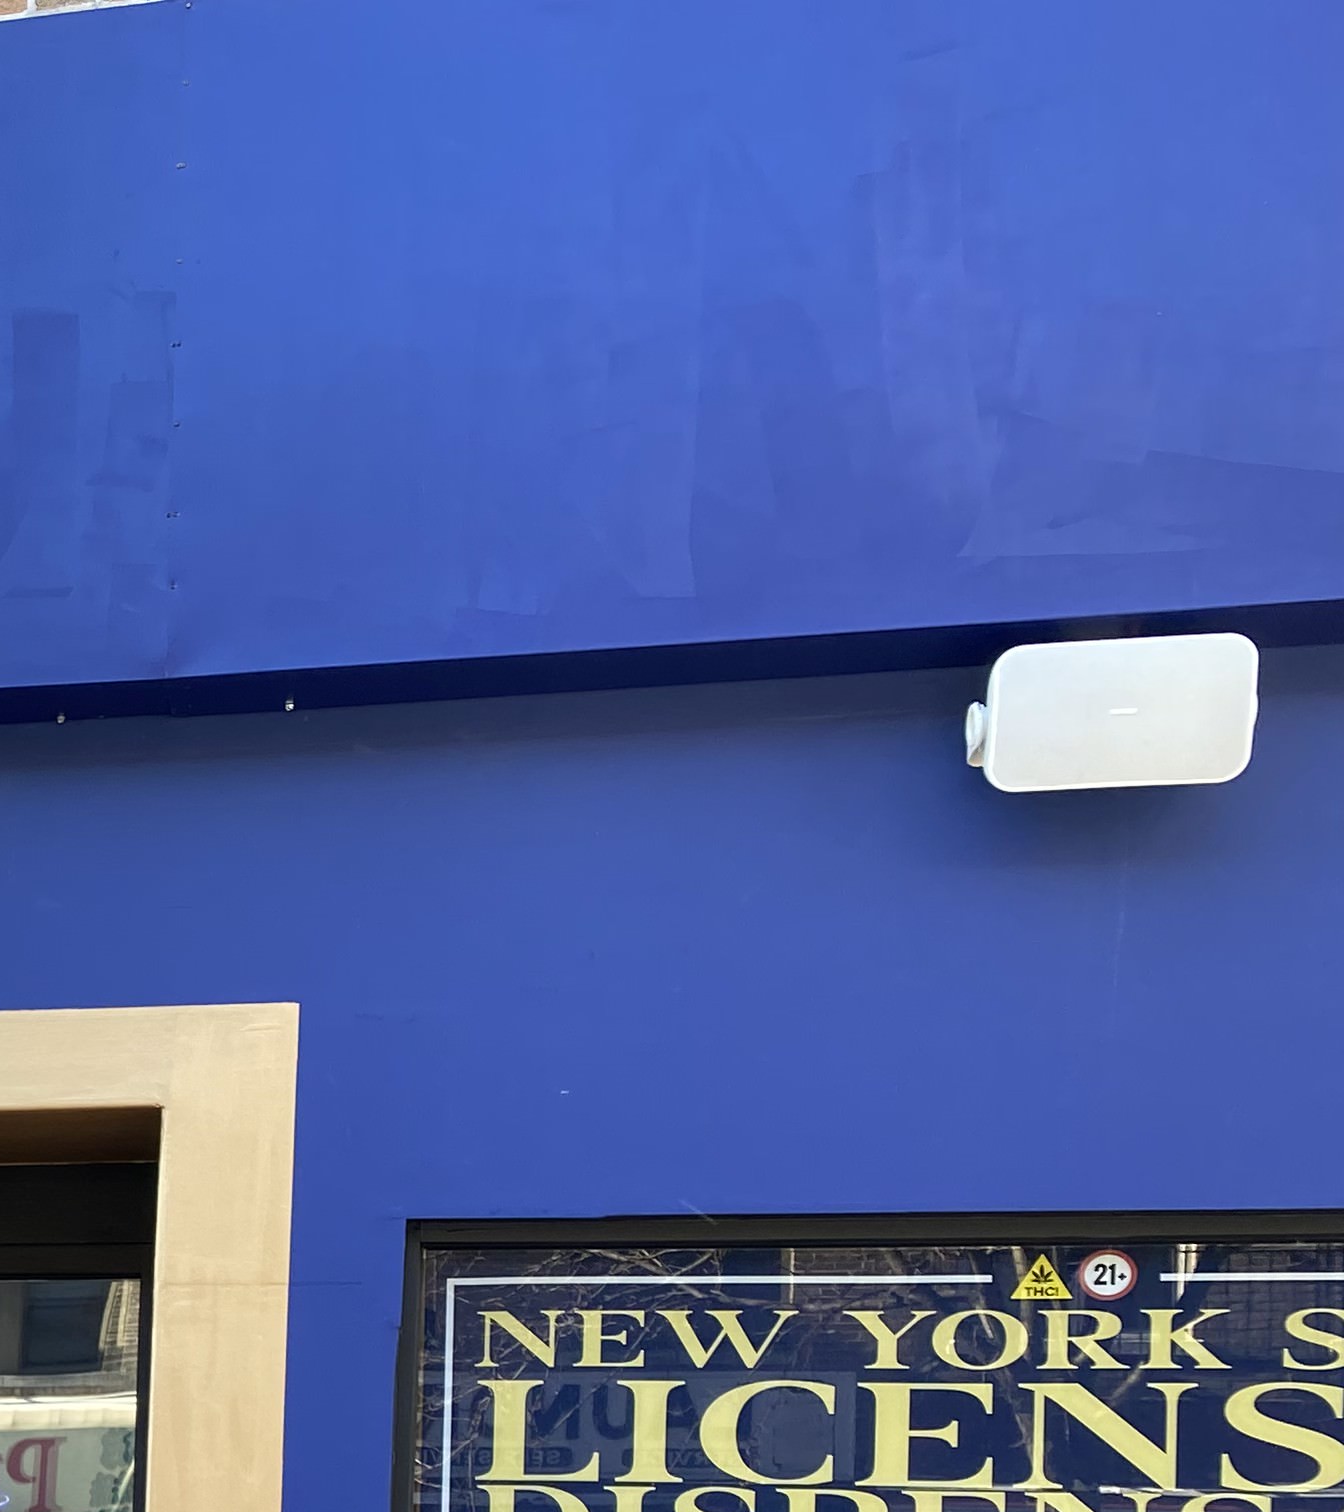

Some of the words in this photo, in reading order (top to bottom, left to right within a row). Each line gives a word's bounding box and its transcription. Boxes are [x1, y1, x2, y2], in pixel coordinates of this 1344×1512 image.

[1094, 1263, 1127, 1286] 21+
[475, 1309, 797, 1368] NEW
[843, 1308, 1232, 1370] YORK
